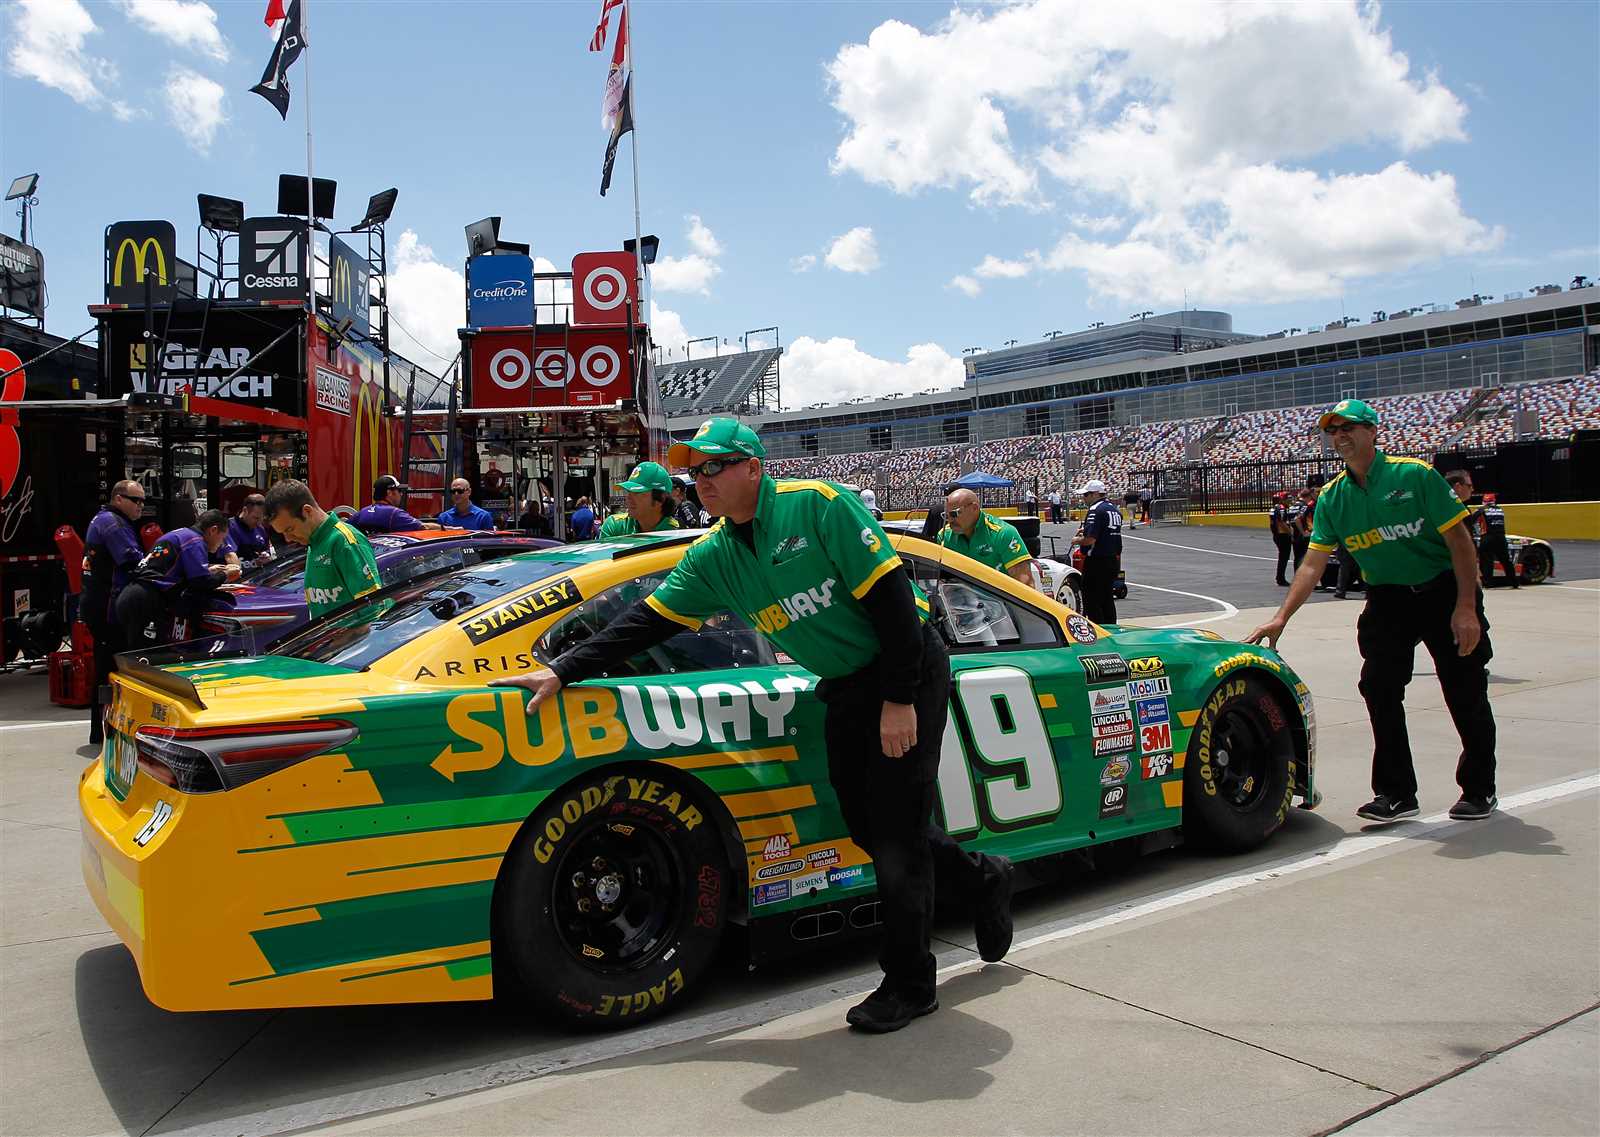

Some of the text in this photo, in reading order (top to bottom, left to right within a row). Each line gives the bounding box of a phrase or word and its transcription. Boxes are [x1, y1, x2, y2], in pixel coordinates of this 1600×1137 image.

[244, 274, 298, 288] Cessna
[317, 392, 350, 410] RACING
[1345, 517, 1424, 553] SUBWAY
[472, 582, 572, 637] STANLEY
[1129, 680, 1157, 697] Mobil
[429, 671, 811, 783] SUBWAY
[1093, 713, 1125, 727] LINCOLN
[1101, 723, 1129, 734] WELDERS
[1095, 735, 1133, 756] FLOWMASTER
[1142, 724, 1171, 751] 3M
[936, 664, 1063, 834] 19
[764, 850, 791, 860] TOOLS
[807, 849, 835, 863] LINCOLN
[813, 856, 838, 868] WELDERS
[760, 861, 802, 876] FREIGHTLINER
[830, 868, 862, 882] DOOSAN
[795, 876, 823, 890] SIEMENS
[595, 968, 684, 1016] EAGLE
